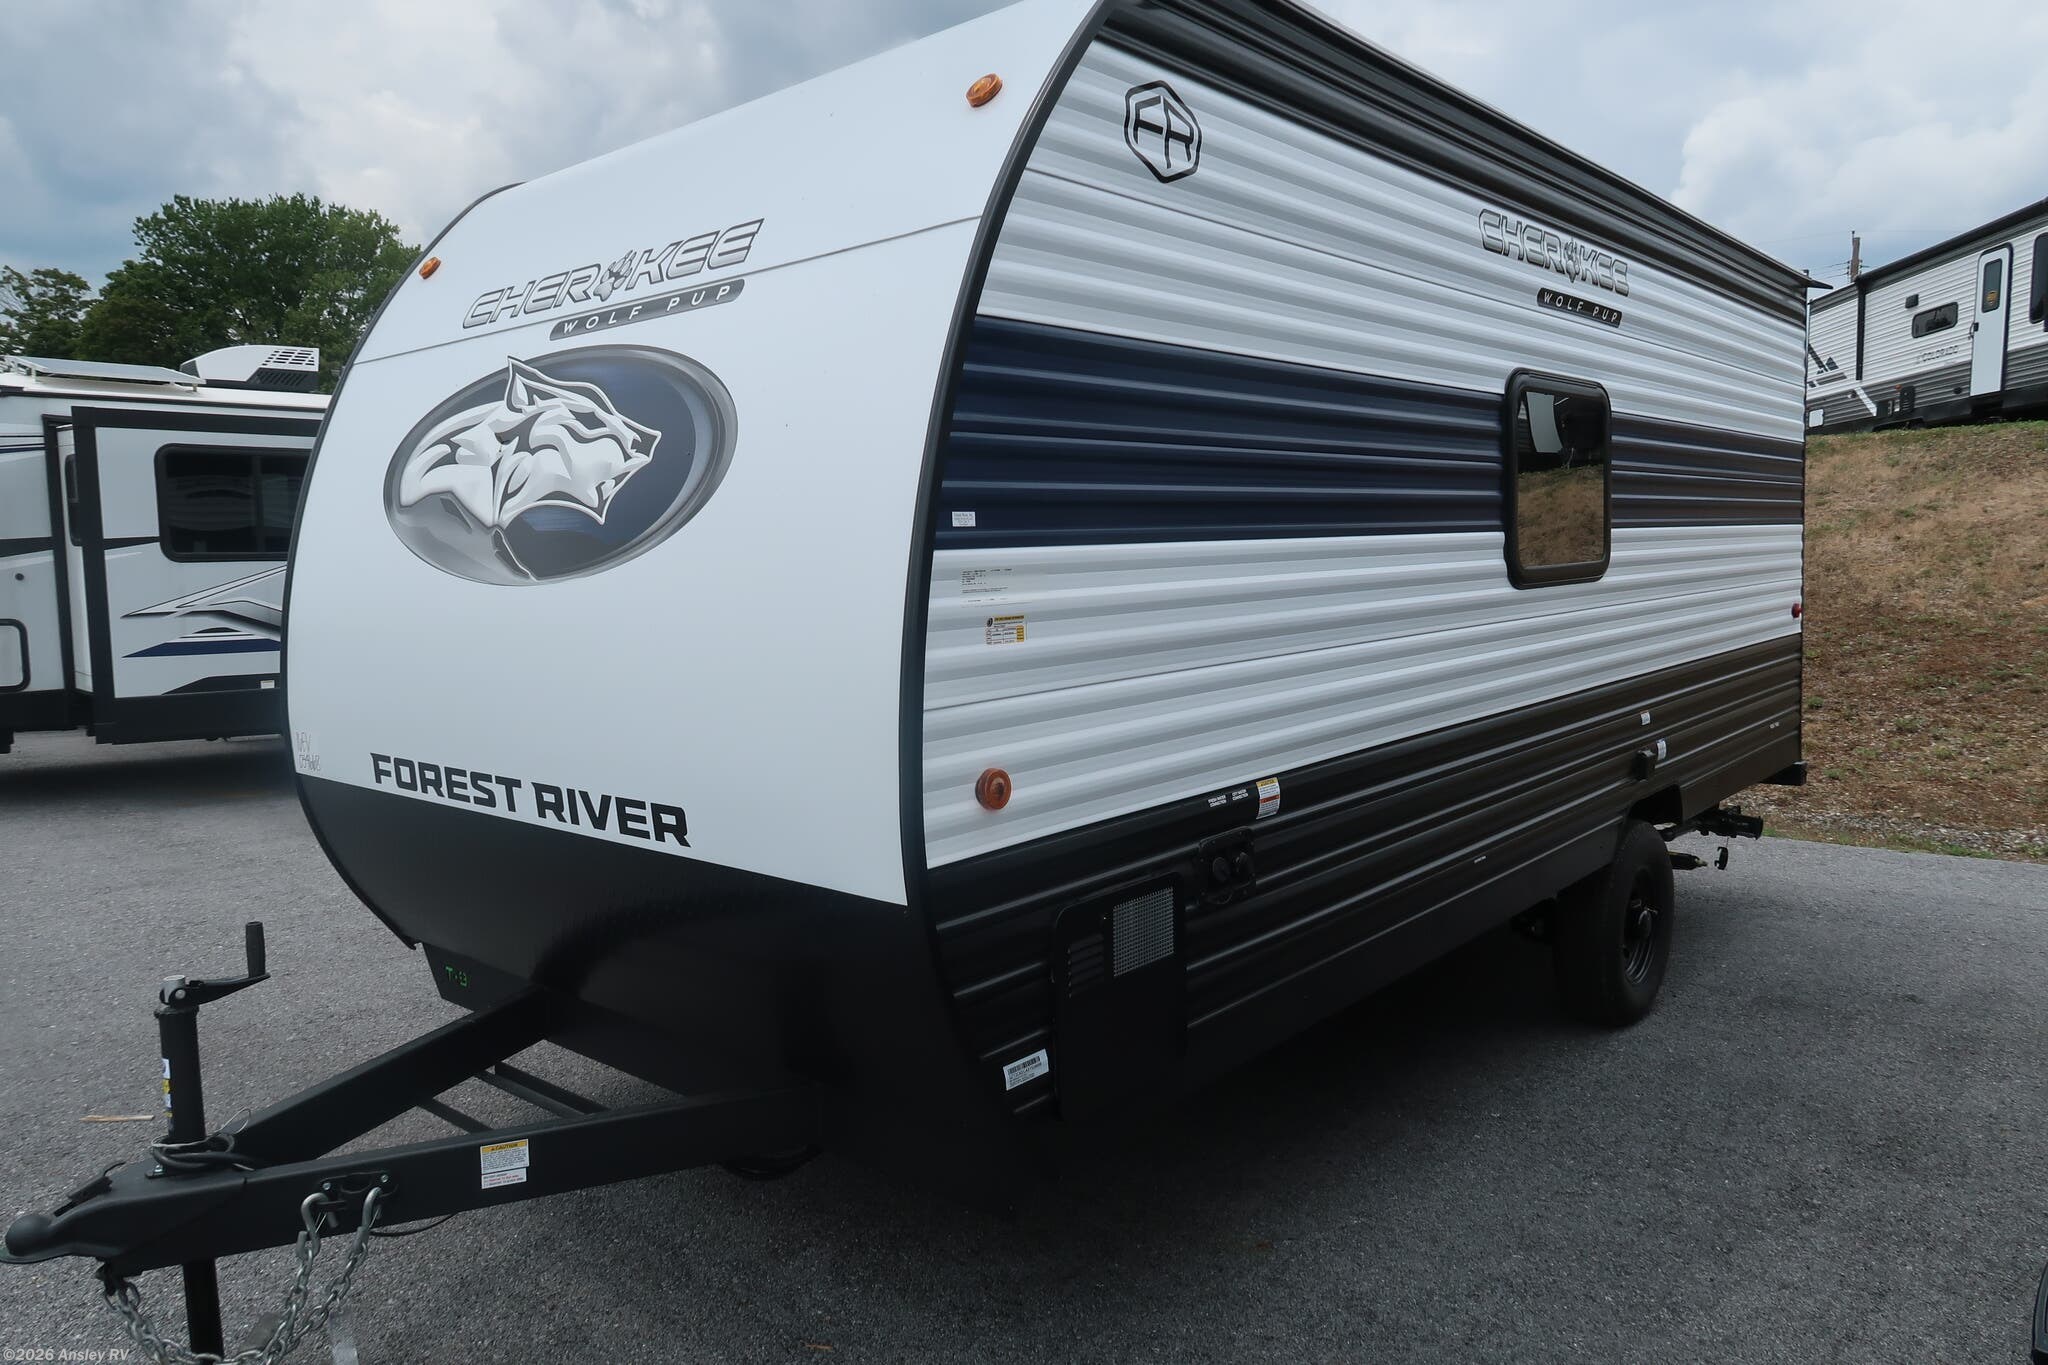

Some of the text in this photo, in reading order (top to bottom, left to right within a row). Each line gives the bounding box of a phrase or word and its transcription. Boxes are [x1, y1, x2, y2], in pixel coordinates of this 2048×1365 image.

[463, 218, 764, 328] CHEROKEE
[1543, 291, 1618, 323] WOLF PUP
[563, 285, 731, 334] WOLF PUP
[370, 752, 691, 848] FOREST RIVER
